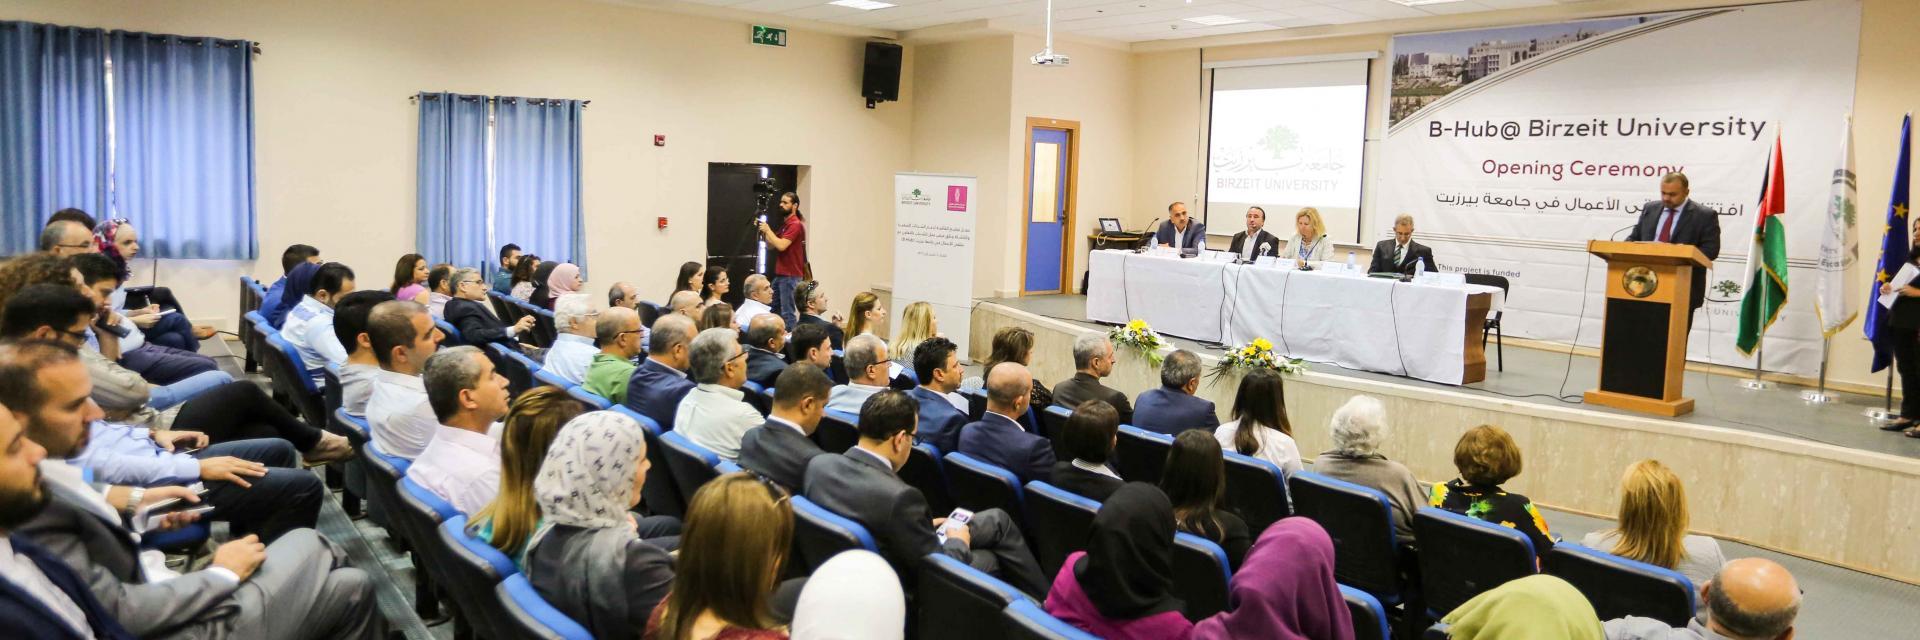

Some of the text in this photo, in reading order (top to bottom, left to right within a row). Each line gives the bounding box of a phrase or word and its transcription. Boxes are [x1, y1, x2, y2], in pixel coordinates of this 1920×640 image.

[1429, 116, 1766, 141] B-Hub@ Birzeit University
[1482, 159, 1563, 181] Opening
[1216, 177, 1338, 192] BIRZEIT UNIVERSITY
[1436, 193, 1479, 207] بيرزيت
[1483, 192, 1530, 210] جامعة
[1535, 196, 1560, 213] في
[1565, 196, 1619, 211] الأعمال
[1438, 263, 1453, 271] This
[1455, 266, 1481, 274] project
[1493, 269, 1521, 278] funded
